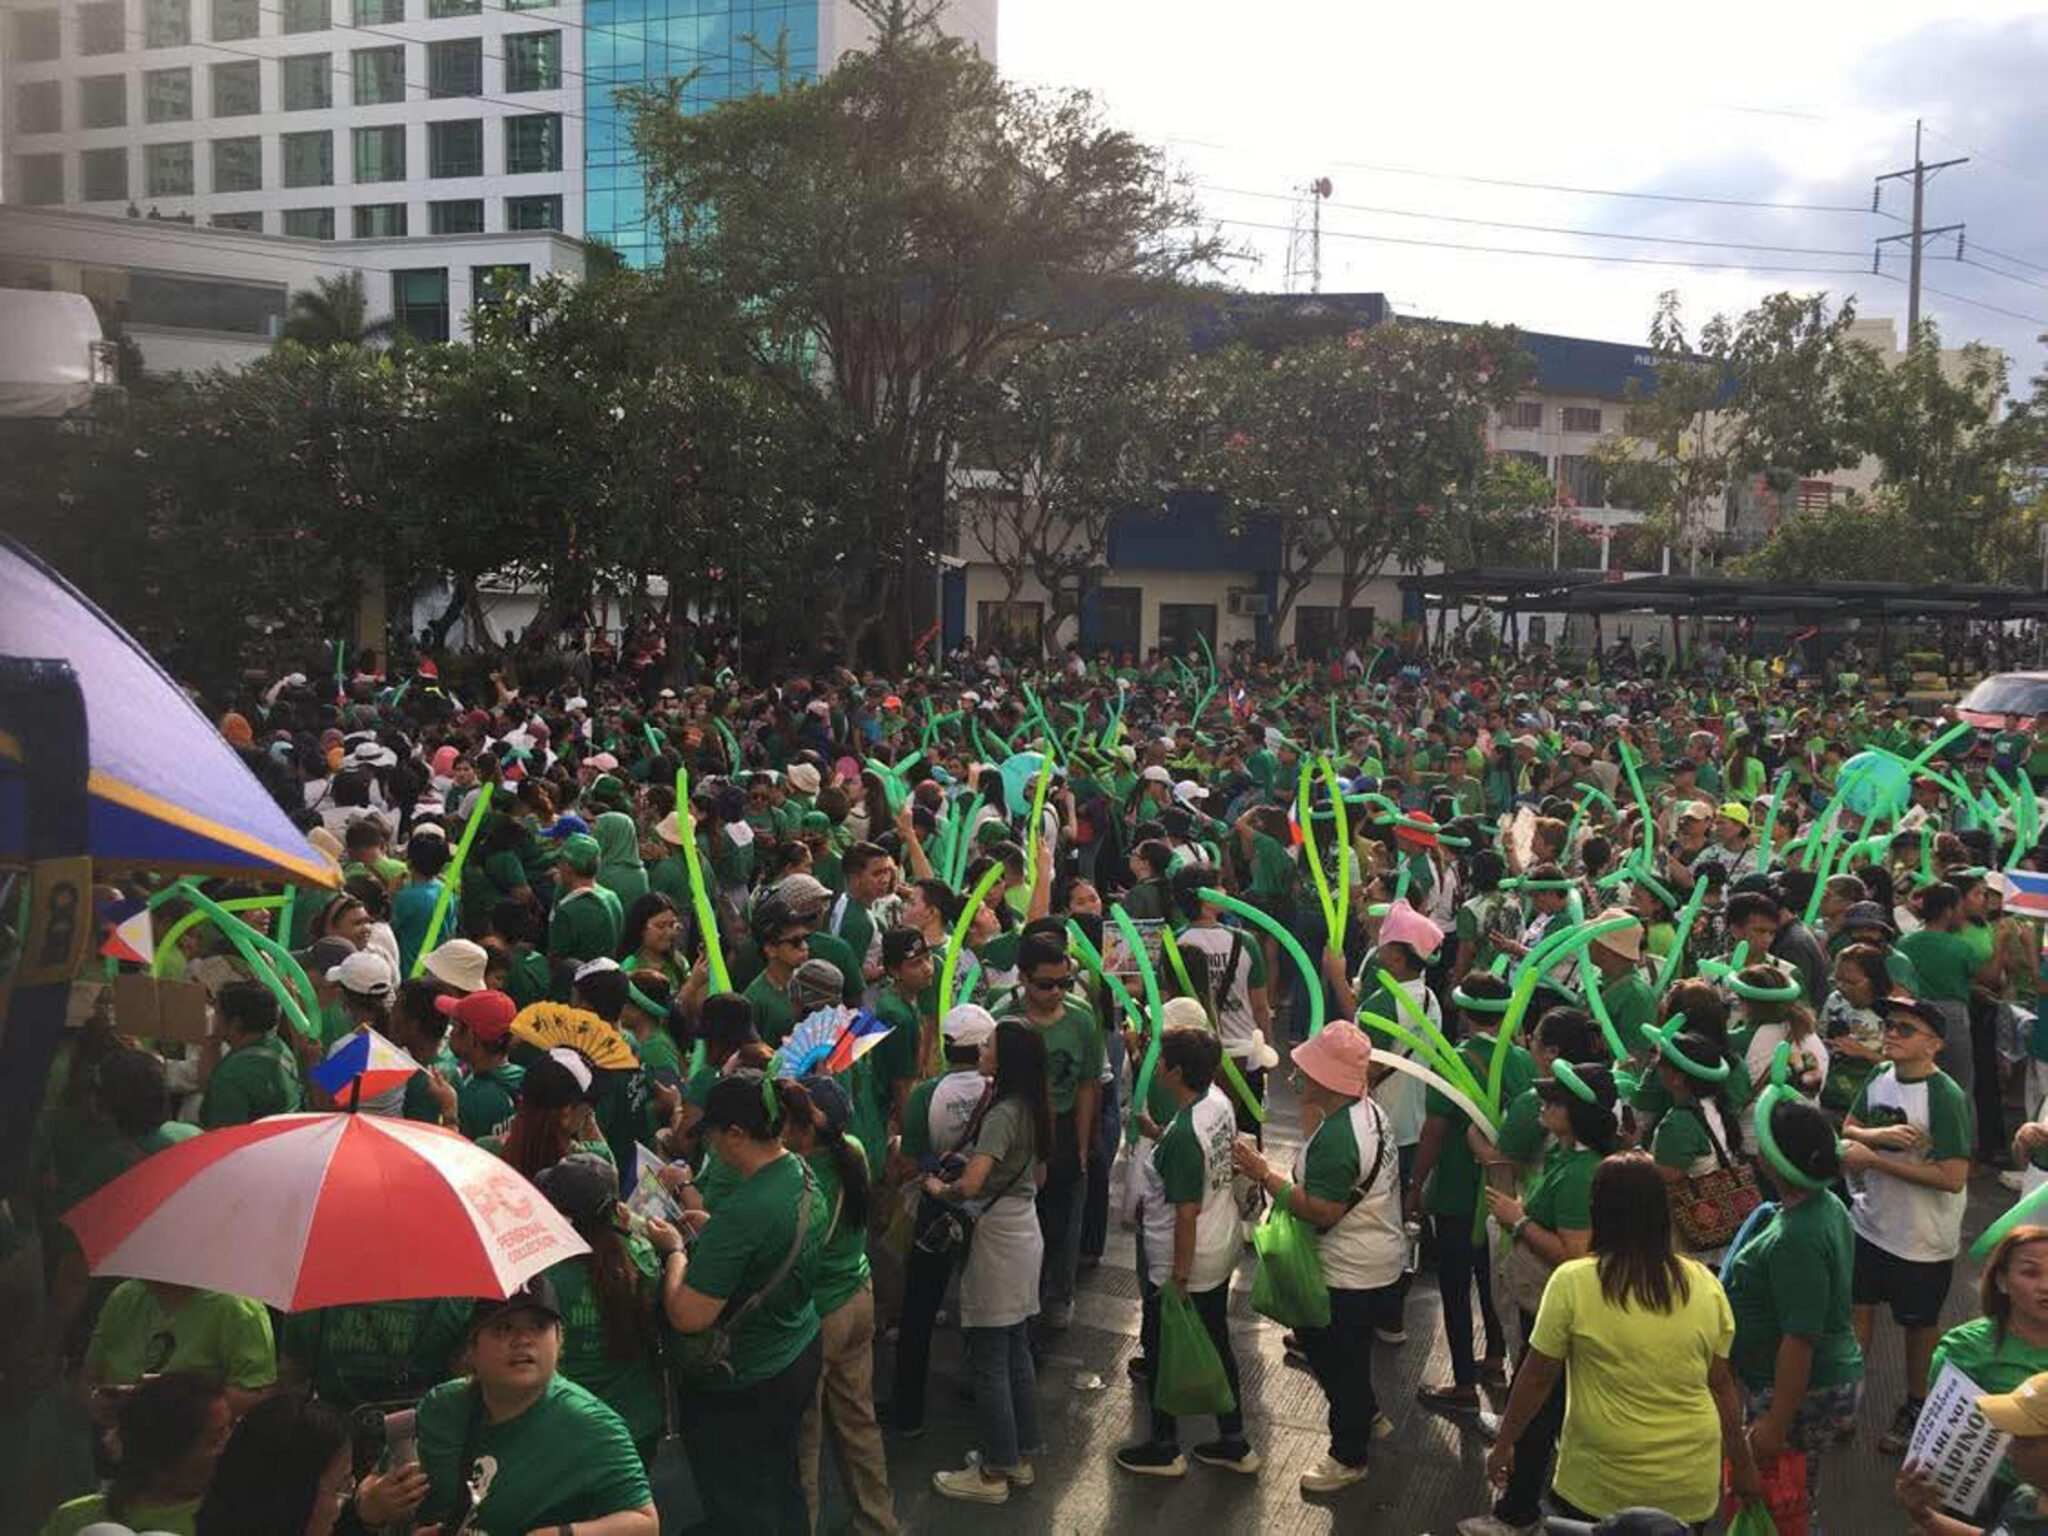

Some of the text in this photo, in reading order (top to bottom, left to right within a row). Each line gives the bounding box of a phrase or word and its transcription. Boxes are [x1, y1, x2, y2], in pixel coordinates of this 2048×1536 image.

[461, 1176, 533, 1233] PC
[496, 1220, 547, 1247] PERSONAL
[508, 1233, 555, 1263] COLLECTION
[1931, 1429, 1951, 1458] ARE
[1947, 1396, 1970, 1428] NOT
[1936, 1403, 1986, 1493] ILIPINO
[1953, 1427, 2002, 1505] FOR NOTHIN
